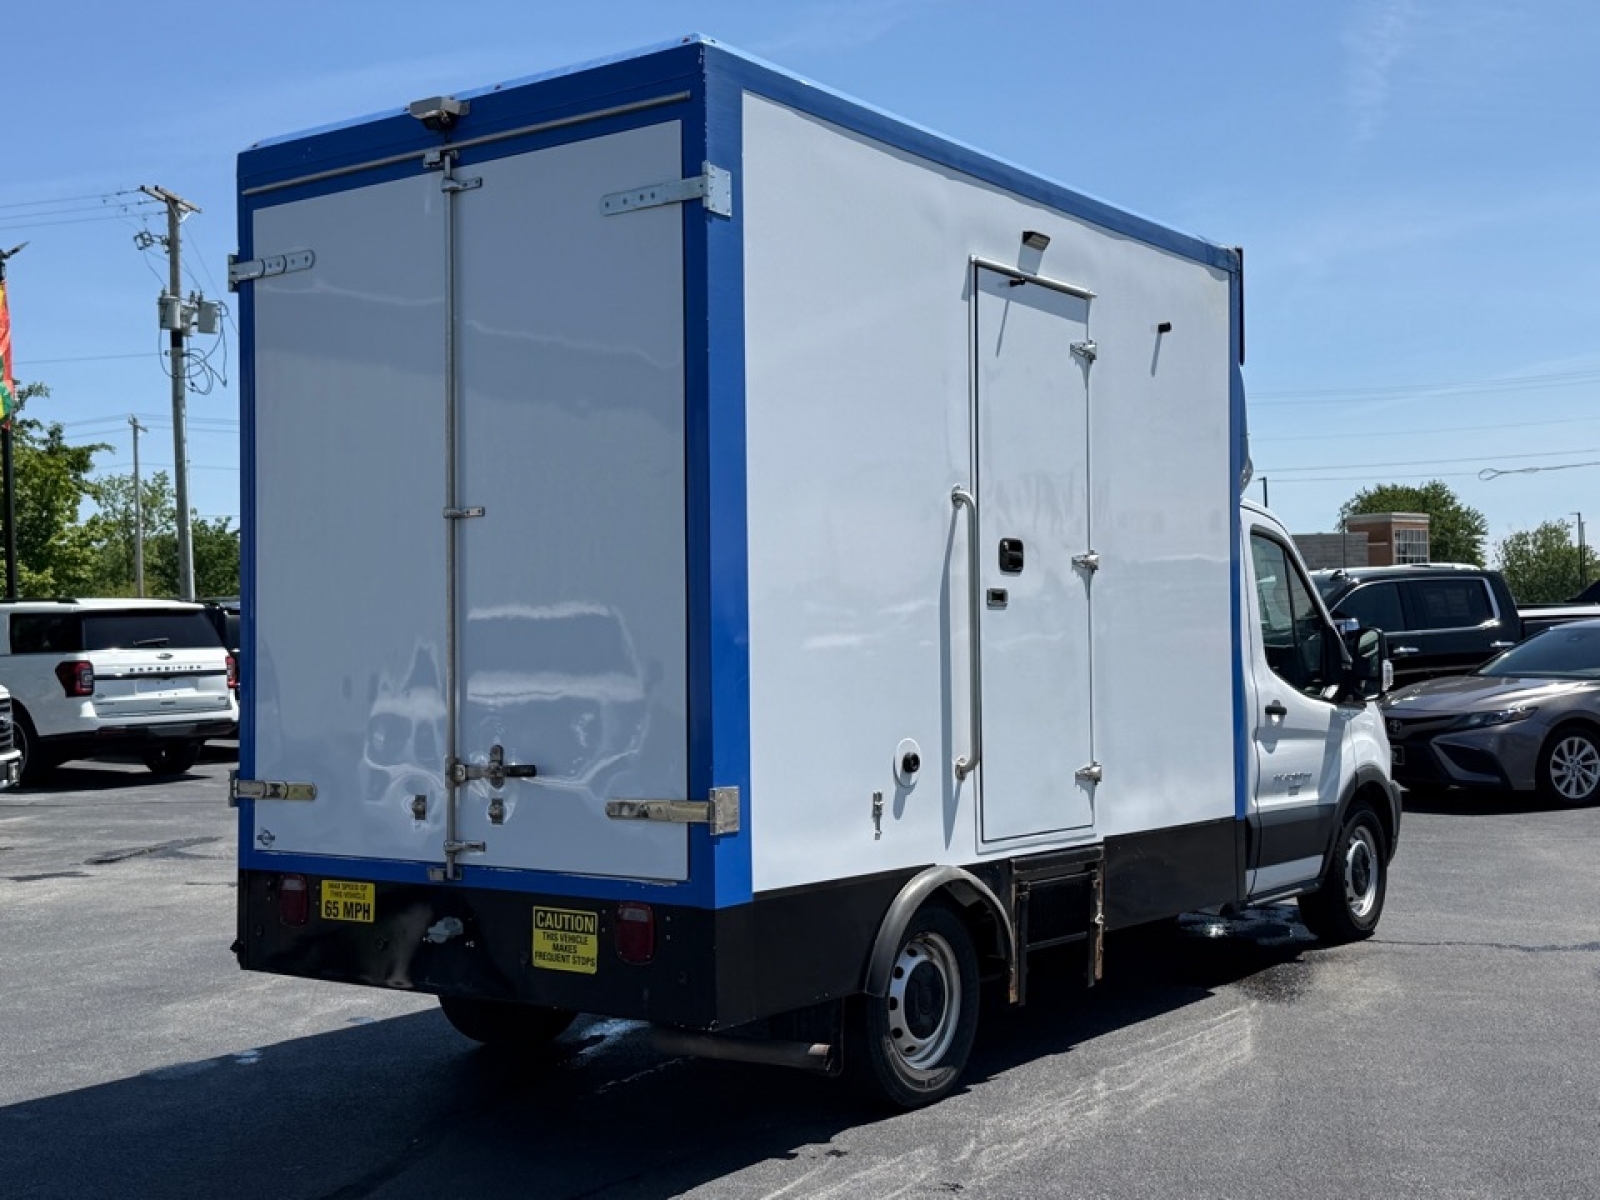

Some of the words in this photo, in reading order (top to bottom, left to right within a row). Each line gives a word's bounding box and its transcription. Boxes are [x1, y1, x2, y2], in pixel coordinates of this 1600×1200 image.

[325, 900, 339, 918] 65
[343, 901, 371, 920] MPH
[536, 911, 594, 932] CAUTION
[543, 932, 558, 942] THIS
[560, 934, 588, 945] VEHICLE
[552, 943, 578, 954] MAKES
[535, 952, 570, 963] FREQUENT
[572, 955, 596, 967] STOPS
